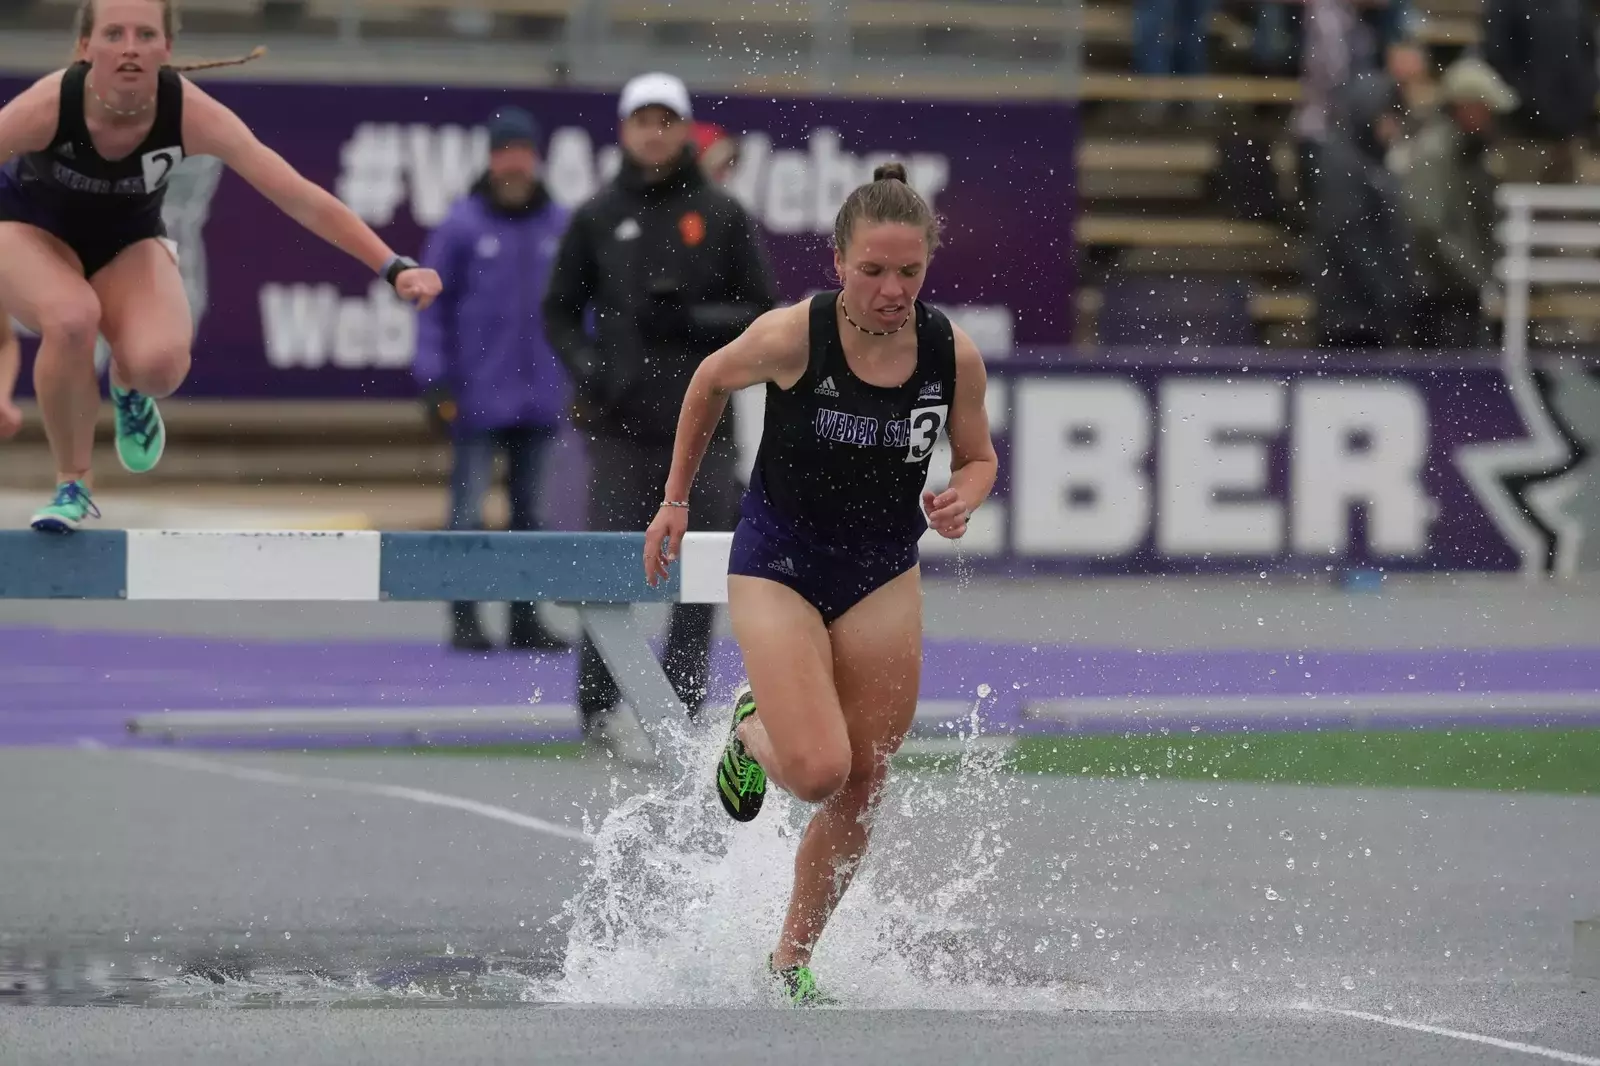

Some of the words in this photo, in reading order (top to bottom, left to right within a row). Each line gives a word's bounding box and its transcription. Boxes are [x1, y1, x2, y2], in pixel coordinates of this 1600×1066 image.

[814, 387, 840, 398] adidas
[815, 408, 879, 446] WEBER
[883, 418, 911, 446] STA
[911, 411, 941, 458] 3
